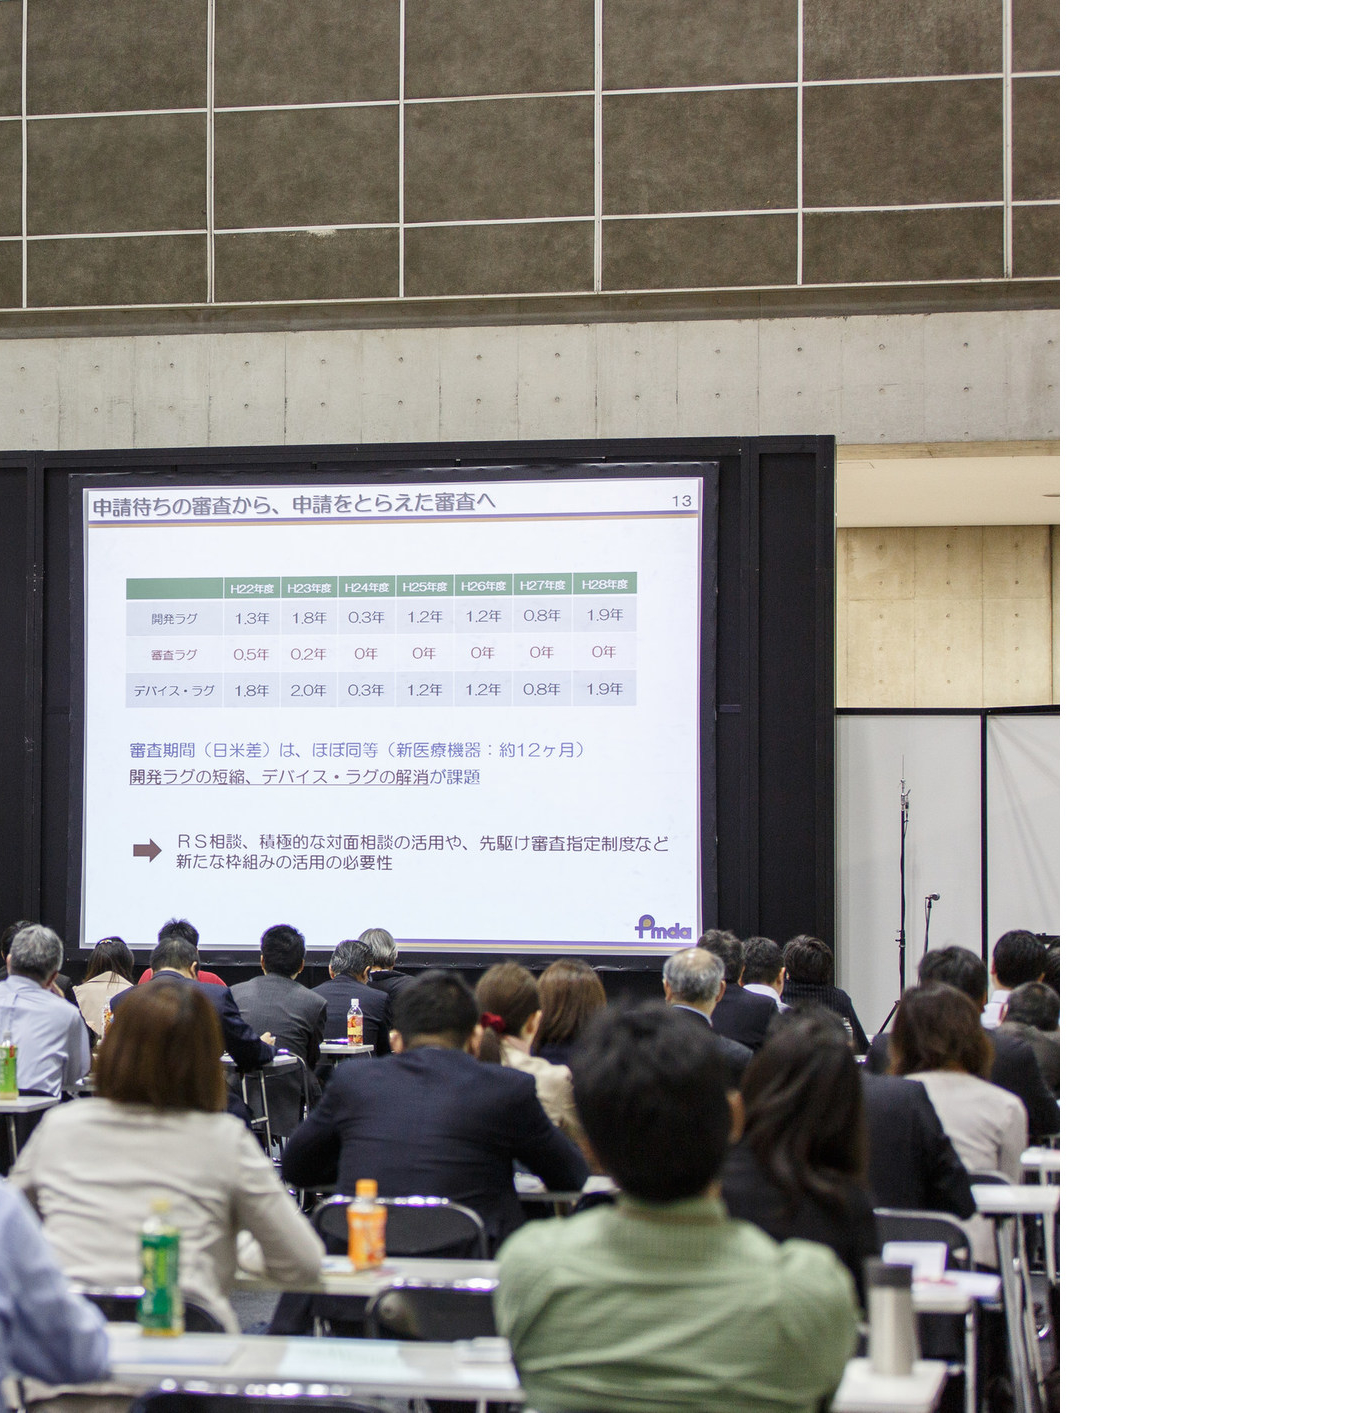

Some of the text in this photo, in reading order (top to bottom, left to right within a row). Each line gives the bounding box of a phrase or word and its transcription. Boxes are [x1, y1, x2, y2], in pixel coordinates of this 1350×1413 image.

[92, 491, 498, 517] 申請待ちの審査から、申請をとらえた審査へ
[671, 494, 693, 509] 13
[230, 578, 629, 595] H22年度 H23年度 H24年度 H25年度 H26年度 H27年度 H28年度
[151, 608, 624, 626] 開発ラグ 1.3年 1.8年 0.3年 1.2年 1.2年 0.8年 1.9年
[151, 645, 617, 661] 審査ラグ 0.5年 0.2年 0年 0年 0年 0年 0年
[133, 682, 624, 698] デバイス・ラグ 1.8年 2.0年 0.3年 1.2年 1.2年 0.8年 1.9年
[128, 768, 481, 786] 開発ラグの短縮、デバイス・ラグの解消が課題
[175, 853, 393, 872] 新たな枠組みの活用の必要性
